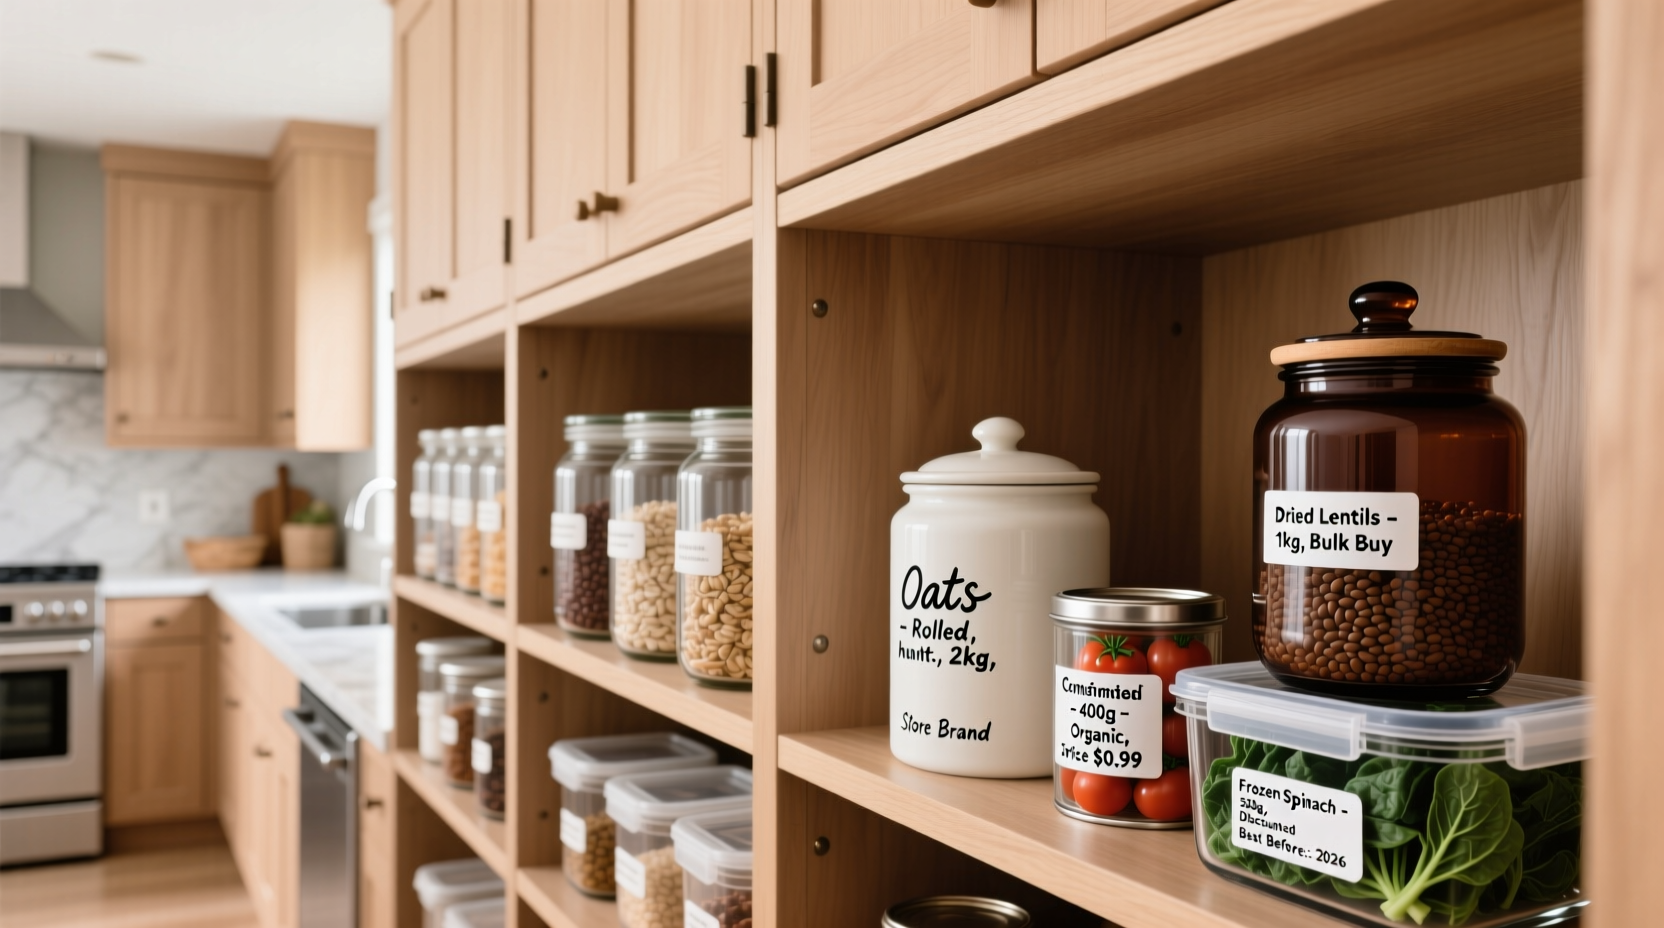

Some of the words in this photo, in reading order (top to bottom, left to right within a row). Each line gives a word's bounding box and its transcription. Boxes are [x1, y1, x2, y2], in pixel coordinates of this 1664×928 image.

[1275, 506, 1314, 524] Dried
[1319, 507, 1381, 526] Lentils
[1275, 531, 1305, 554] 1kg,
[1310, 532, 1350, 551] Bulk
[1355, 534, 1393, 557] Buy
[901, 564, 992, 613] Oats
[912, 617, 976, 645] Rolled,
[948, 645, 997, 673] 2kg,
[1079, 702, 1116, 725] 400g
[938, 718, 992, 742] Brand
[1070, 722, 1130, 747] Organic,
[1093, 746, 1142, 769] $0.99
[1239, 778, 1281, 800] Frozen
[1283, 788, 1336, 815] Spinach
[1315, 848, 1347, 868] 2026
